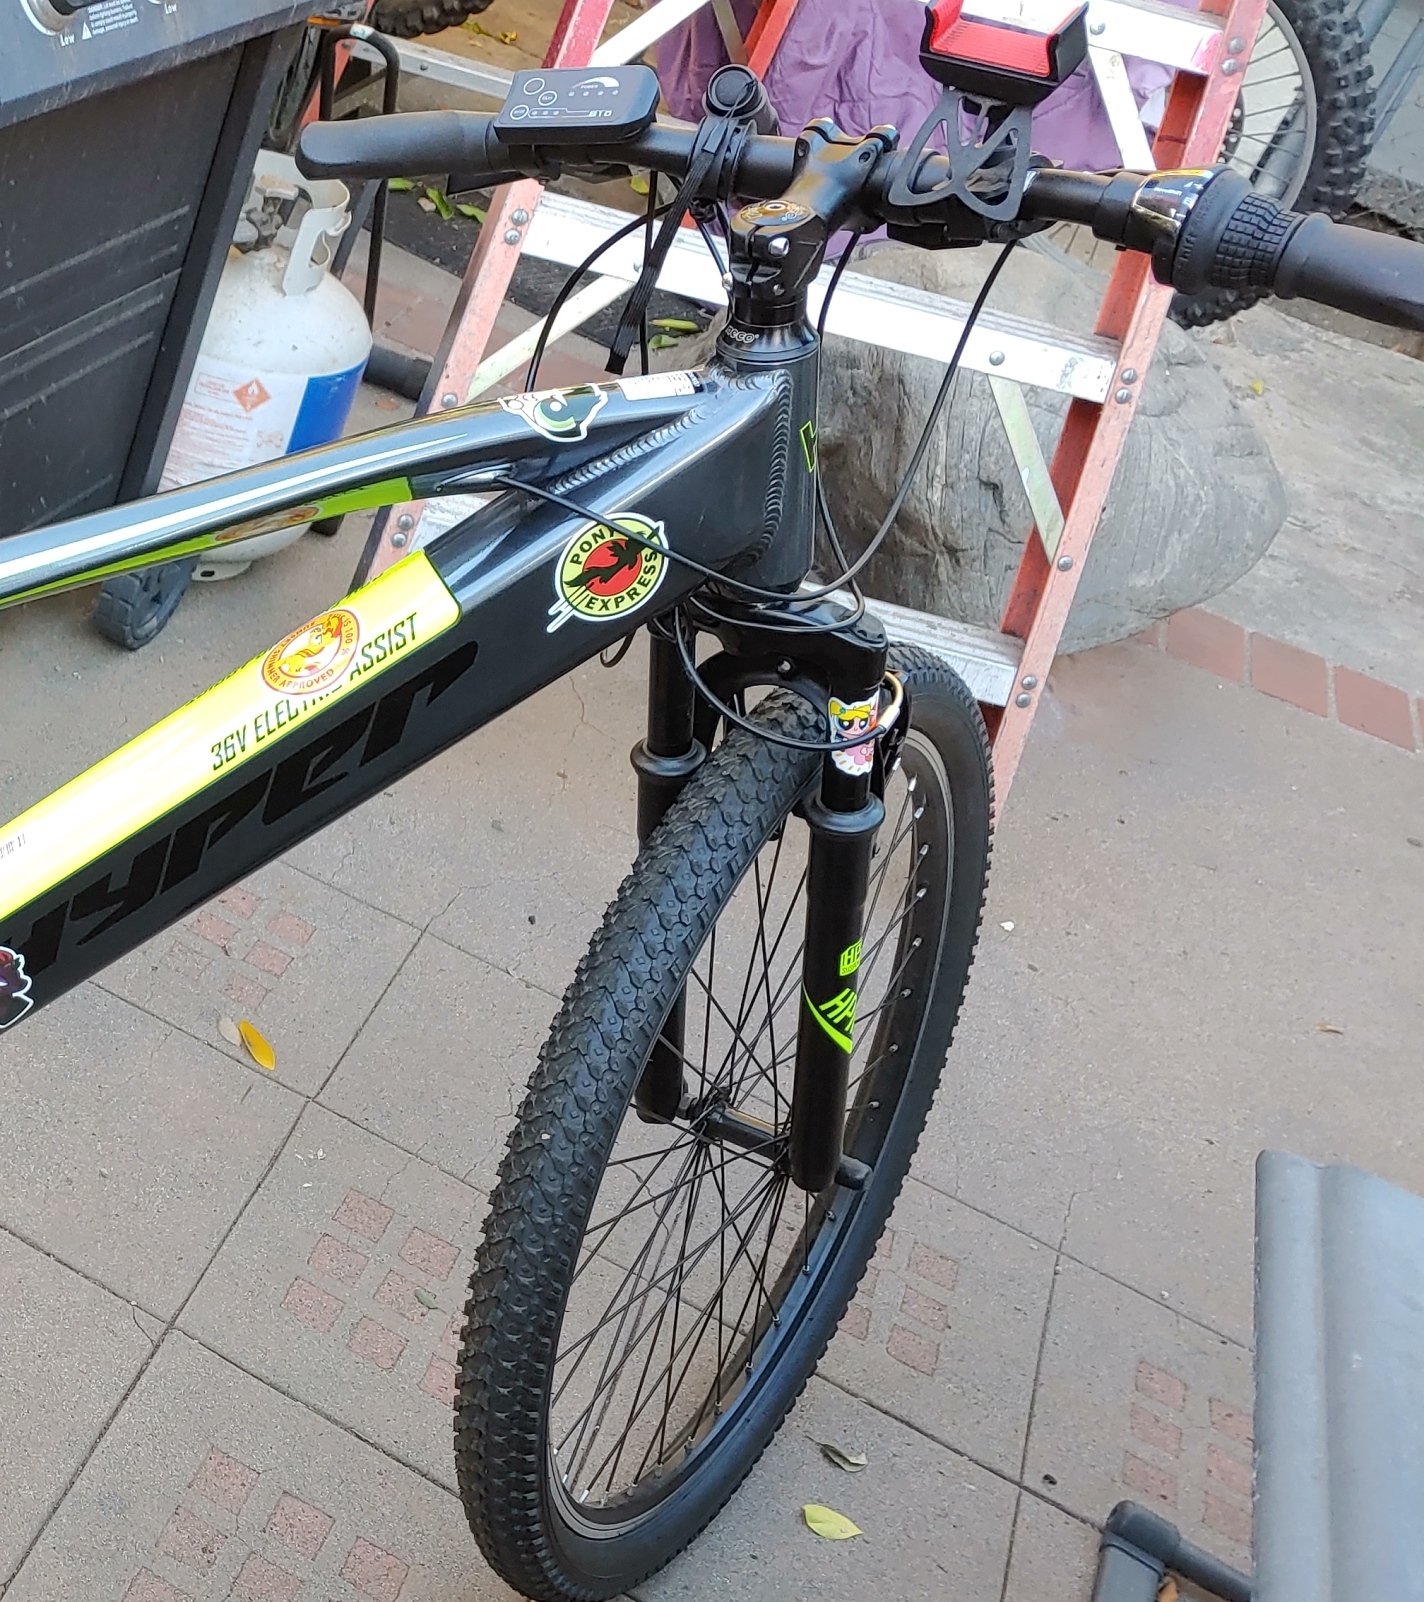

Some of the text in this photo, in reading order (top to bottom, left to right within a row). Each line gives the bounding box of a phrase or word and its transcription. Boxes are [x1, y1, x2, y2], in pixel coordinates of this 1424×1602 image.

[164, 3, 177, 15] Low
[59, 33, 75, 47] Low
[569, 523, 617, 566] PONY
[584, 550, 658, 612] EXPRESS
[210, 724, 247, 771] 36V
[349, 612, 418, 682] ASSIST
[278, 668, 335, 689] APPROVED
